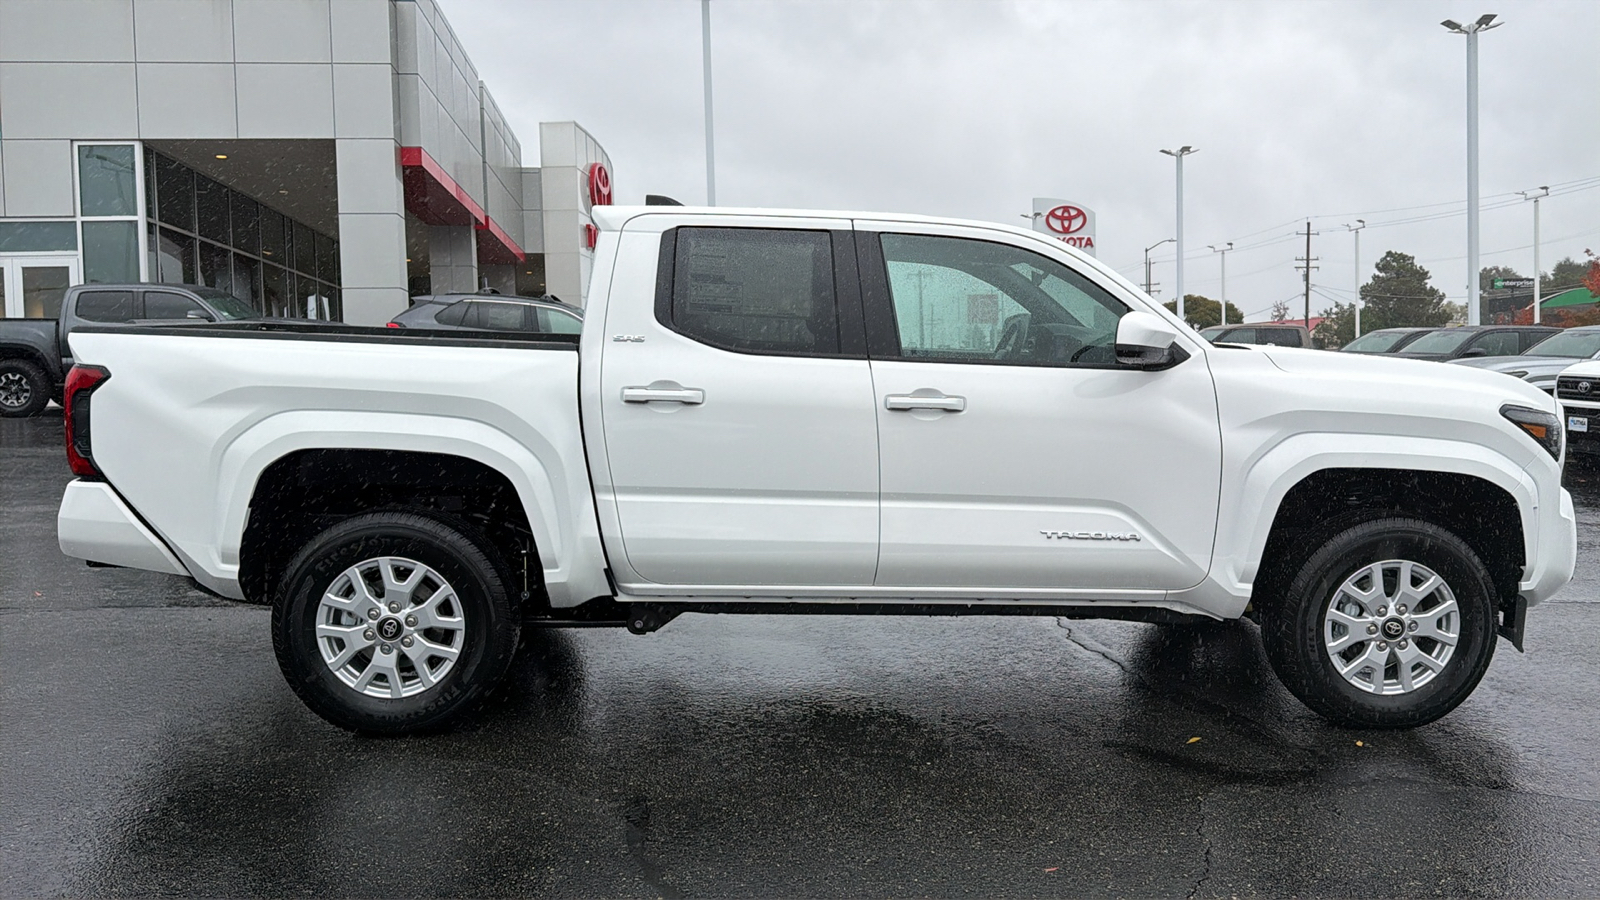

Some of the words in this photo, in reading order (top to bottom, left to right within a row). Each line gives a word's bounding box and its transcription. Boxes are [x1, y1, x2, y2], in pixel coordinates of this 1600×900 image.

[1056, 236, 1094, 248] OTA
[613, 334, 645, 342] SR5
[1040, 530, 1141, 541] TACOMA
[316, 538, 403, 572] Firestone
